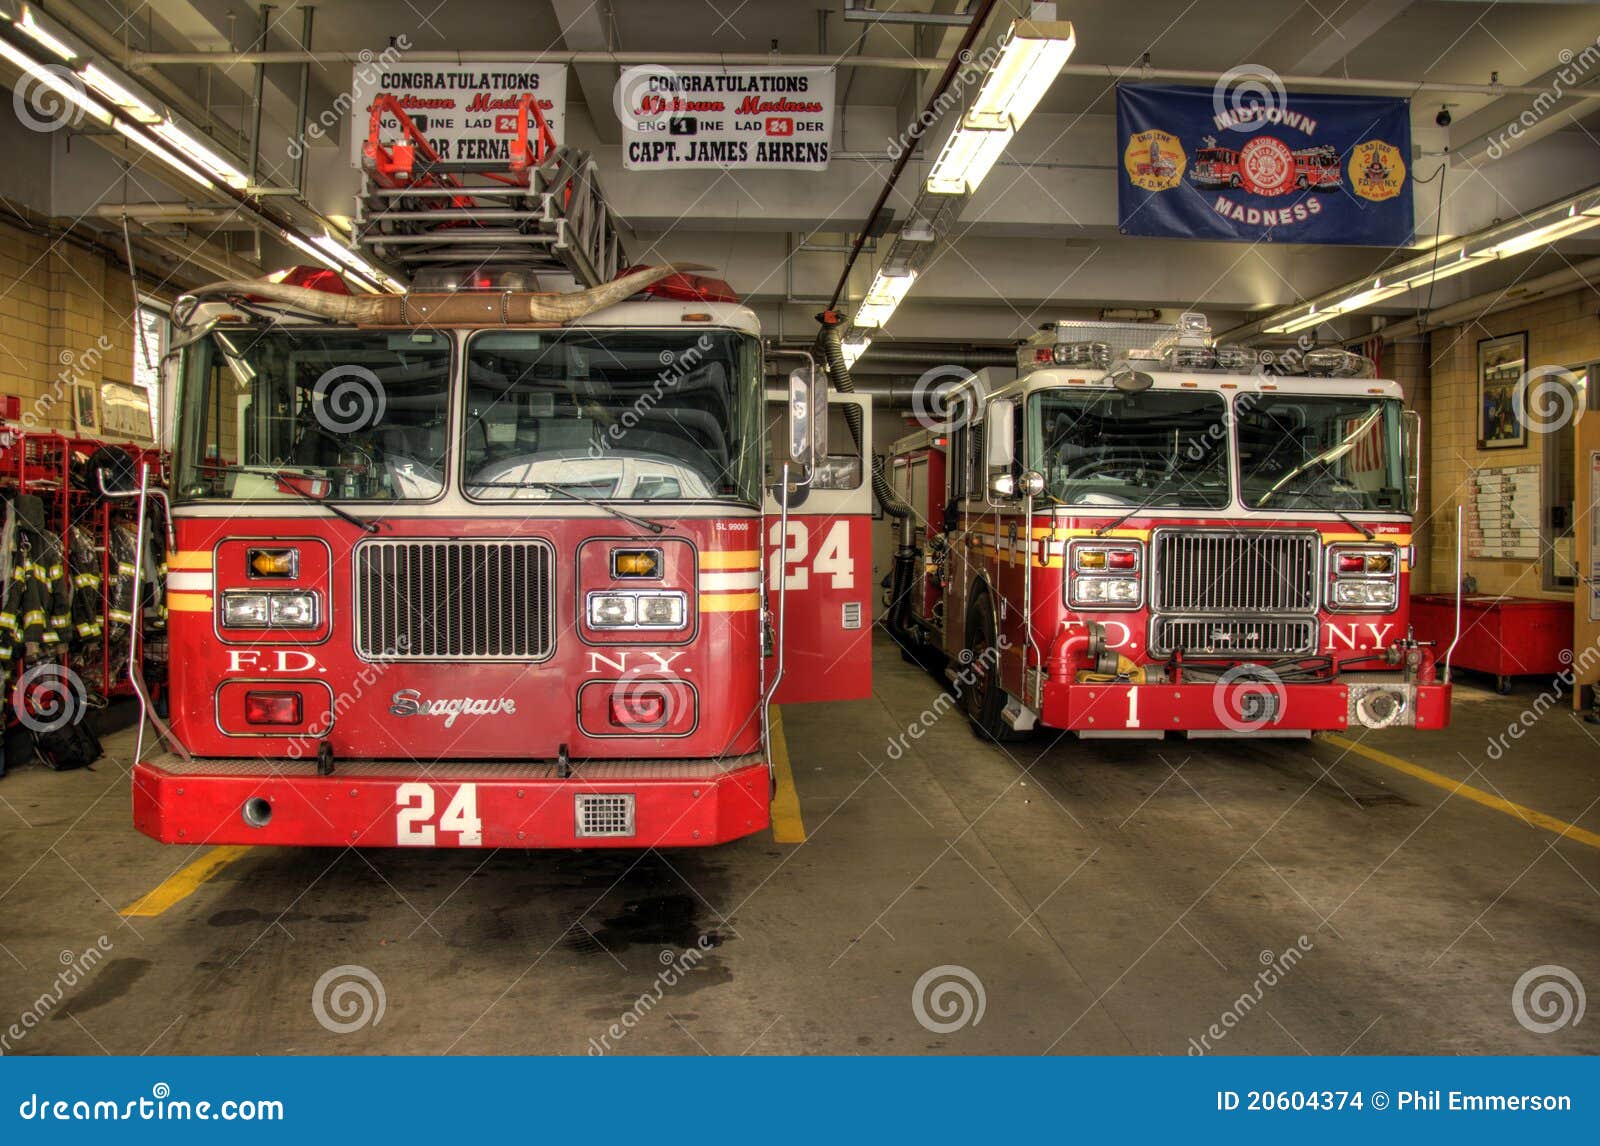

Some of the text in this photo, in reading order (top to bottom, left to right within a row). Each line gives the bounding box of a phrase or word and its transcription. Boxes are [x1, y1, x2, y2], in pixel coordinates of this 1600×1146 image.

[381, 72, 540, 89] CONGRATULATIONS
[648, 75, 809, 92] CONGRATULATIONS
[634, 96, 823, 115] Midtown Madness
[380, 119, 397, 128] NG
[430, 119, 454, 129] INE
[465, 119, 492, 128] LAD
[500, 118, 517, 130] 24
[637, 120, 824, 132] ENG 1 INE LAD 24 DER
[1213, 106, 1318, 136] MIDTOWN
[629, 142, 828, 163] CAPT. JAMES AHRENS
[1214, 196, 1321, 226] MADNESS
[769, 520, 854, 591] 24
[225, 650, 693, 673] F.D. N.Y.
[389, 688, 517, 729] Seagrave
[1125, 685, 1141, 728] 1
[396, 782, 482, 846] 24
